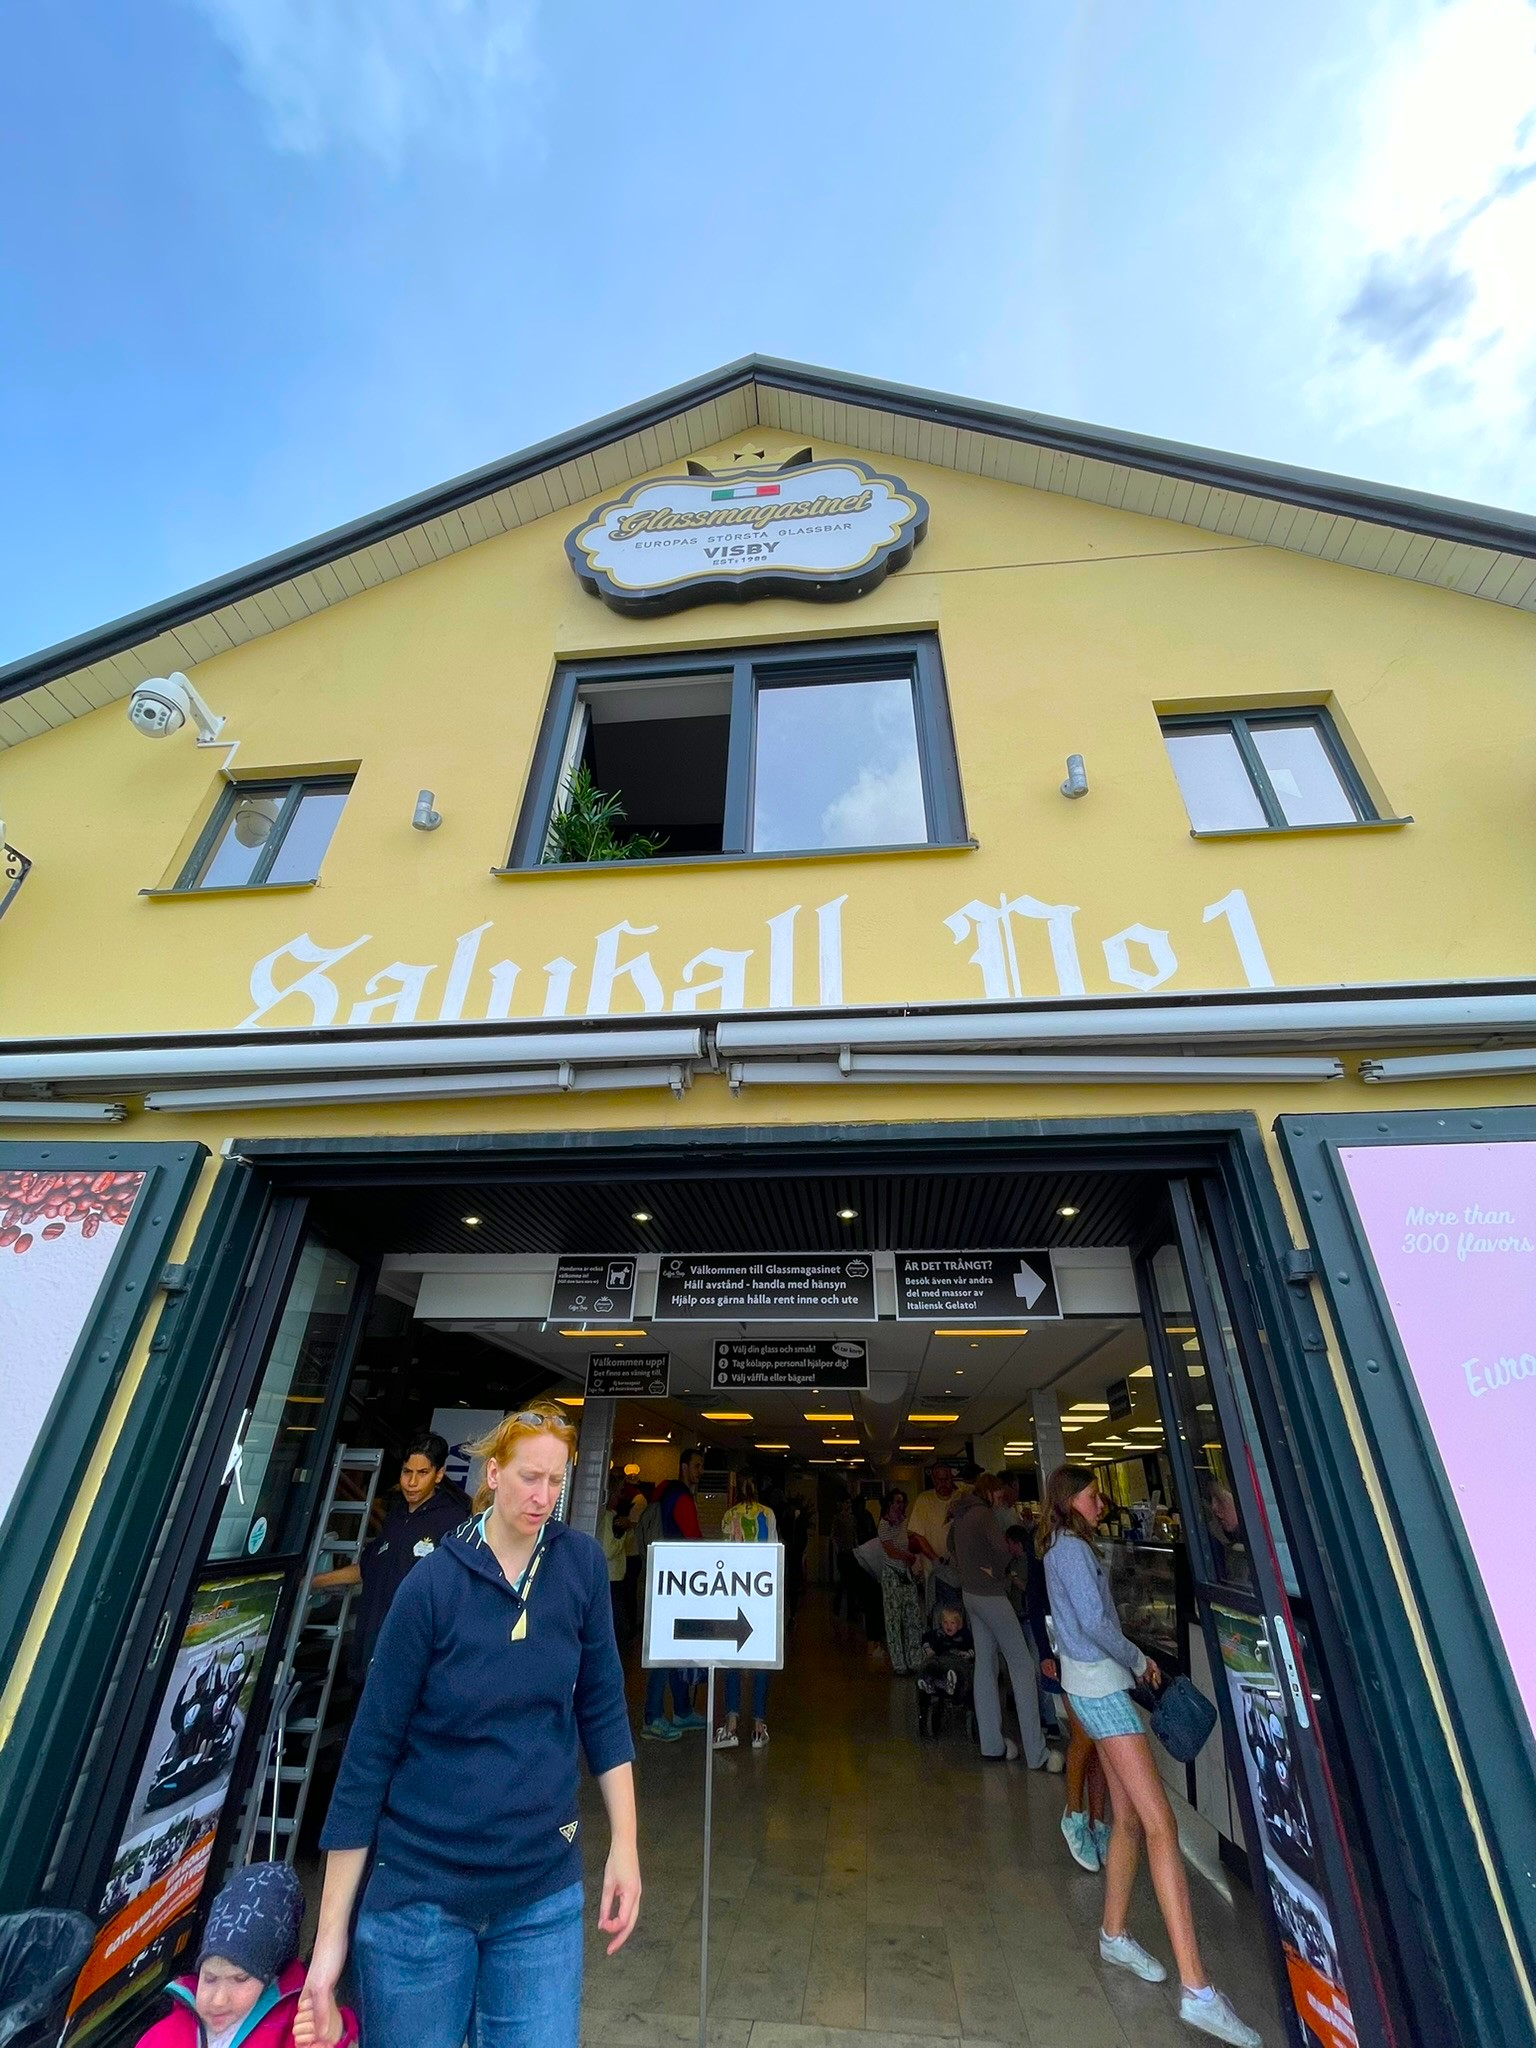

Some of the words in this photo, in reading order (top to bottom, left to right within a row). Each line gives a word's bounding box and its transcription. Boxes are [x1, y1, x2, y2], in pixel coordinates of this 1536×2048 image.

[608, 489, 874, 541] Glassmagasinet
[635, 537, 698, 549] EUROPAS
[707, 532, 769, 543] STÖRSTA
[778, 523, 852, 536] GLASSBAR
[703, 541, 780, 559] VISBY
[943, 893, 1178, 999] No
[1203, 889, 1275, 988] 1
[1405, 1206, 1459, 1226] More
[1464, 1204, 1515, 1225] than
[1402, 1233, 1450, 1254] 300
[1456, 1232, 1535, 1262] flavors
[690, 1264, 747, 1275] Välkommen
[749, 1264, 763, 1274] till
[765, 1264, 841, 1277] Glassmagasinet
[904, 1259, 920, 1271] ÄR
[921, 1261, 941, 1271] DET
[943, 1257, 993, 1271] TRÅNGT?
[683, 1279, 704, 1290] Håll
[705, 1279, 744, 1290] avstånd
[752, 1279, 786, 1289] handla
[787, 1278, 810, 1289] med
[811, 1278, 847, 1292] hänsyn
[905, 1276, 930, 1285] Besök
[931, 1277, 952, 1285] även
[953, 1275, 967, 1285] vår
[968, 1275, 994, 1285] andra
[671, 1294, 698, 1307] Hjälp
[699, 1297, 716, 1305] oss
[717, 1295, 745, 1307] gärna
[746, 1293, 772, 1305] hålla
[773, 1295, 795, 1305] rent
[796, 1294, 819, 1305] inne
[820, 1293, 839, 1305] och
[841, 1295, 859, 1305] ute
[906, 1288, 920, 1298] del
[921, 1288, 940, 1298] med
[941, 1290, 972, 1298] massor
[907, 1301, 944, 1311] Italiensk
[944, 1301, 978, 1311] Gelato!
[732, 1344, 747, 1355] Välj
[747, 1344, 760, 1353] din
[760, 1344, 779, 1356] glass
[779, 1344, 794, 1354] och
[592, 1357, 645, 1367] Välkommen
[731, 1359, 746, 1370] Tag
[774, 1358, 807, 1370] personal
[807, 1358, 834, 1370] hjälper
[731, 1373, 746, 1384] Välj
[746, 1372, 769, 1382] våffla
[769, 1372, 787, 1382] eller
[657, 1559, 774, 1597] INGÅNG
